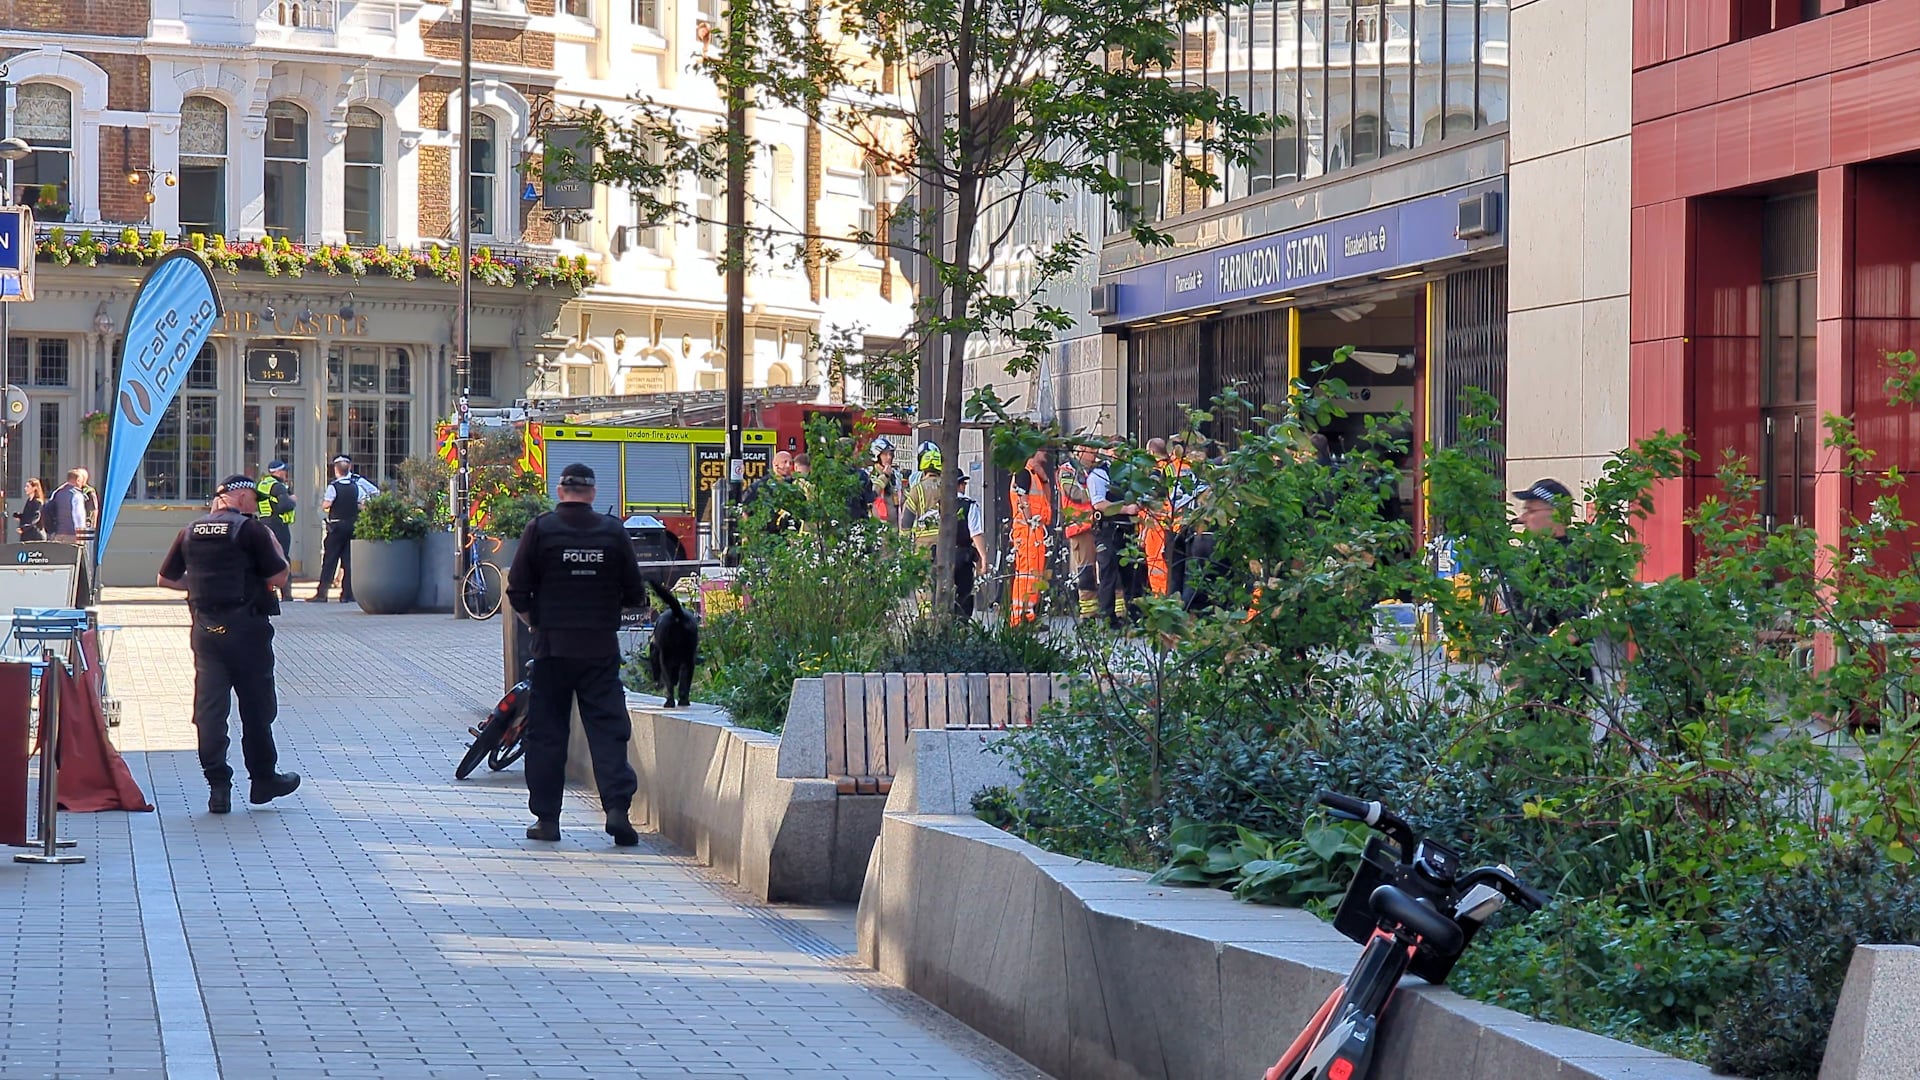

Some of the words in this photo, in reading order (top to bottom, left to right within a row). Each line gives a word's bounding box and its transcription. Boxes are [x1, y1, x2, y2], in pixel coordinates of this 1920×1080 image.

[555, 184, 580, 192] CASTLE
[1345, 231, 1368, 257] Elizabeth
[1368, 230, 1379, 252] line
[1219, 245, 1281, 294] FARRINGDON
[1286, 233, 1328, 280] STATION
[1175, 270, 1197, 293] Thameslink
[213, 311, 258, 334] HE
[272, 311, 369, 337] CASTLE
[139, 309, 178, 372] Cafe
[626, 429, 689, 440] london-fire.gov.uk
[700, 451, 719, 459] PLAN
[194, 526, 229, 535] POLICE
[563, 553, 604, 562] POLICE
